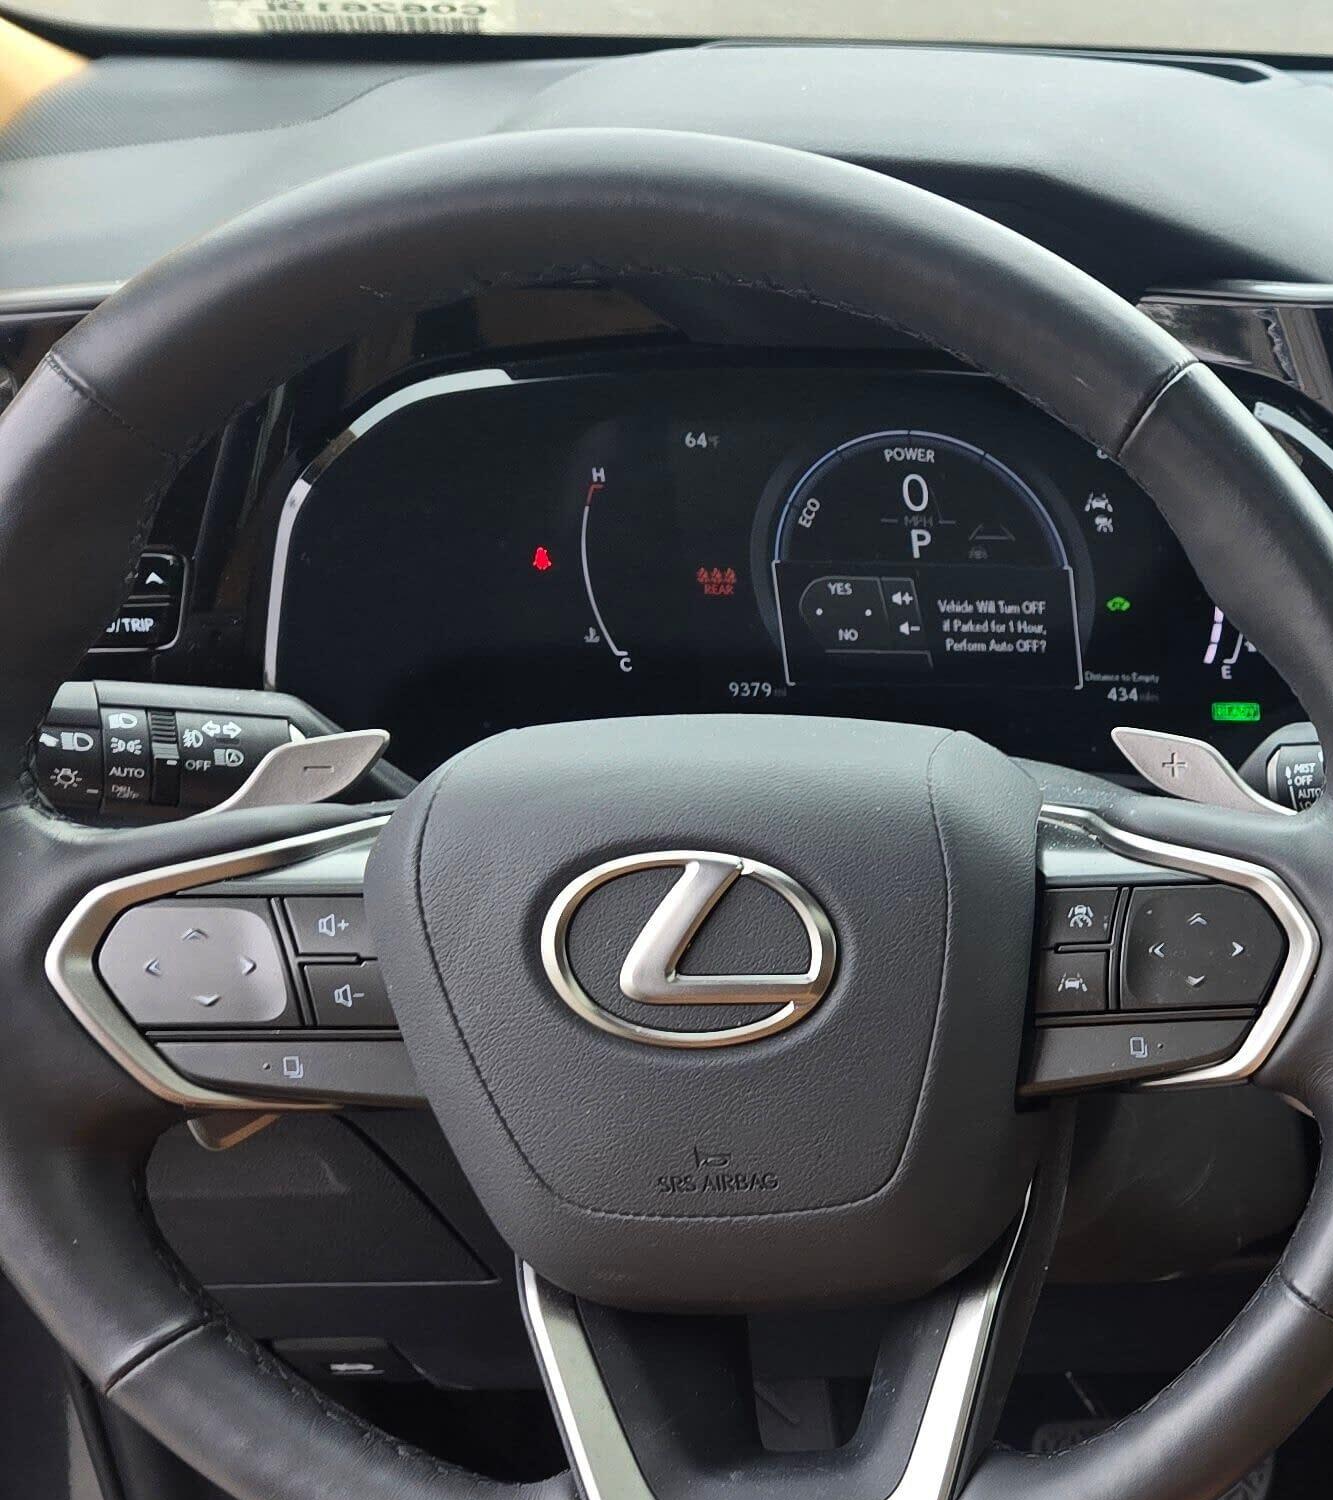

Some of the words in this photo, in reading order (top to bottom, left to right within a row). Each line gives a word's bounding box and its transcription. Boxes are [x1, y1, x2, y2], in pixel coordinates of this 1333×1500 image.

[883, 447, 935, 463] POWER
[591, 467, 606, 483] H
[902, 473, 929, 513] 0
[798, 498, 821, 529] ECO
[910, 528, 932, 559] P
[704, 583, 735, 595] REAR
[827, 582, 853, 596] YES
[937, 599, 974, 614] Vehicle
[976, 600, 996, 614] Will
[998, 600, 1020, 614] Turn
[1021, 600, 1047, 615] OFF
[952, 618, 989, 633] Parked
[990, 618, 1006, 633] for
[1008, 619, 1015, 633] 1
[838, 629, 859, 642] NO
[945, 638, 987, 653] Perform
[989, 639, 1014, 652] Auto
[1015, 639, 1047, 653] OFF?
[619, 657, 633, 672] C
[1221, 665, 1233, 680] E
[728, 682, 772, 697] 9379
[1107, 686, 1138, 702] 434
[108, 766, 145, 779] AUTO
[184, 759, 212, 772] OFF
[1293, 762, 1317, 775] MIST
[1294, 775, 1313, 787] OFF
[1298, 787, 1323, 799] AUTO
[658, 1174, 699, 1194] SRS
[702, 1171, 780, 1194] AIRBAG
